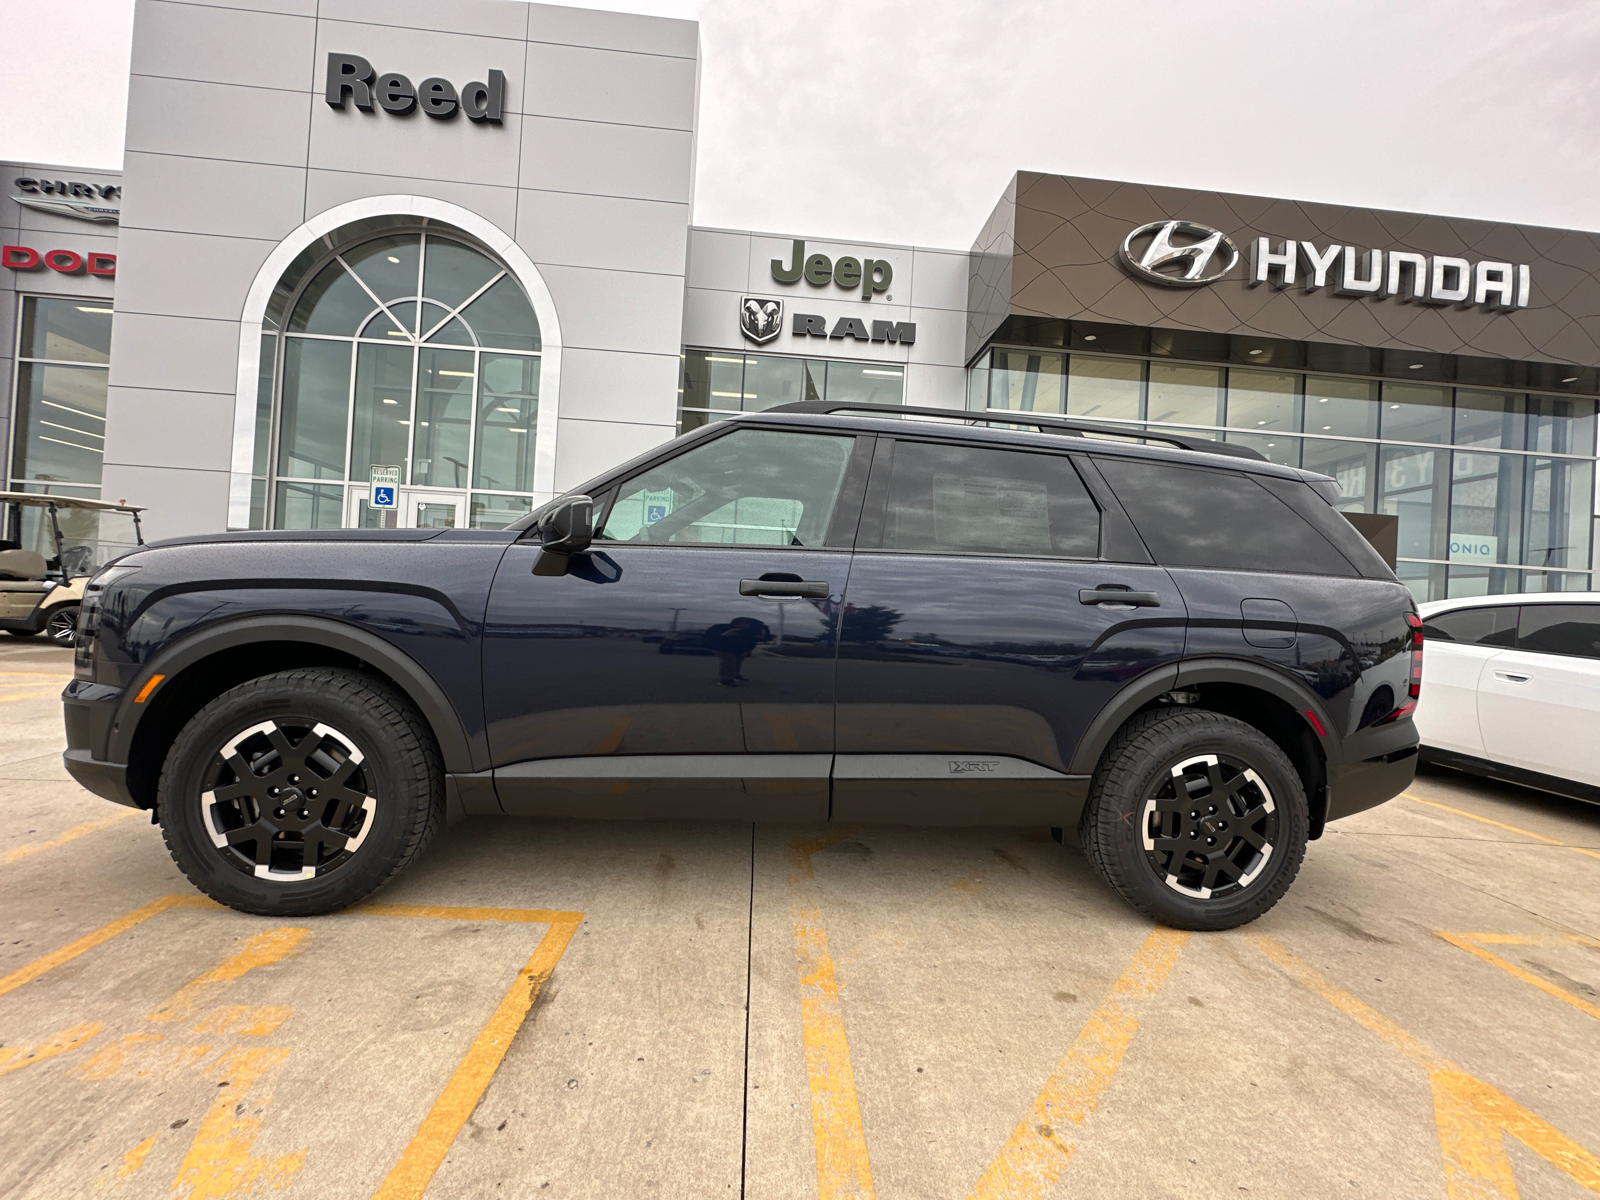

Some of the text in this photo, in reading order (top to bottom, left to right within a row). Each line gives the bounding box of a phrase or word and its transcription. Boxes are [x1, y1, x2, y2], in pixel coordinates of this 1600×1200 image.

[326, 52, 505, 124] Reed
[770, 239, 893, 301] Jeep
[1251, 236, 1530, 307] HYUNDAI
[792, 313, 917, 345] RAM
[372, 468, 398, 476] RESERVED
[372, 476, 398, 484] PARKING
[645, 494, 670, 502] PARKING
[1449, 542, 1490, 555] ONIQ
[949, 761, 1000, 774] XRT
